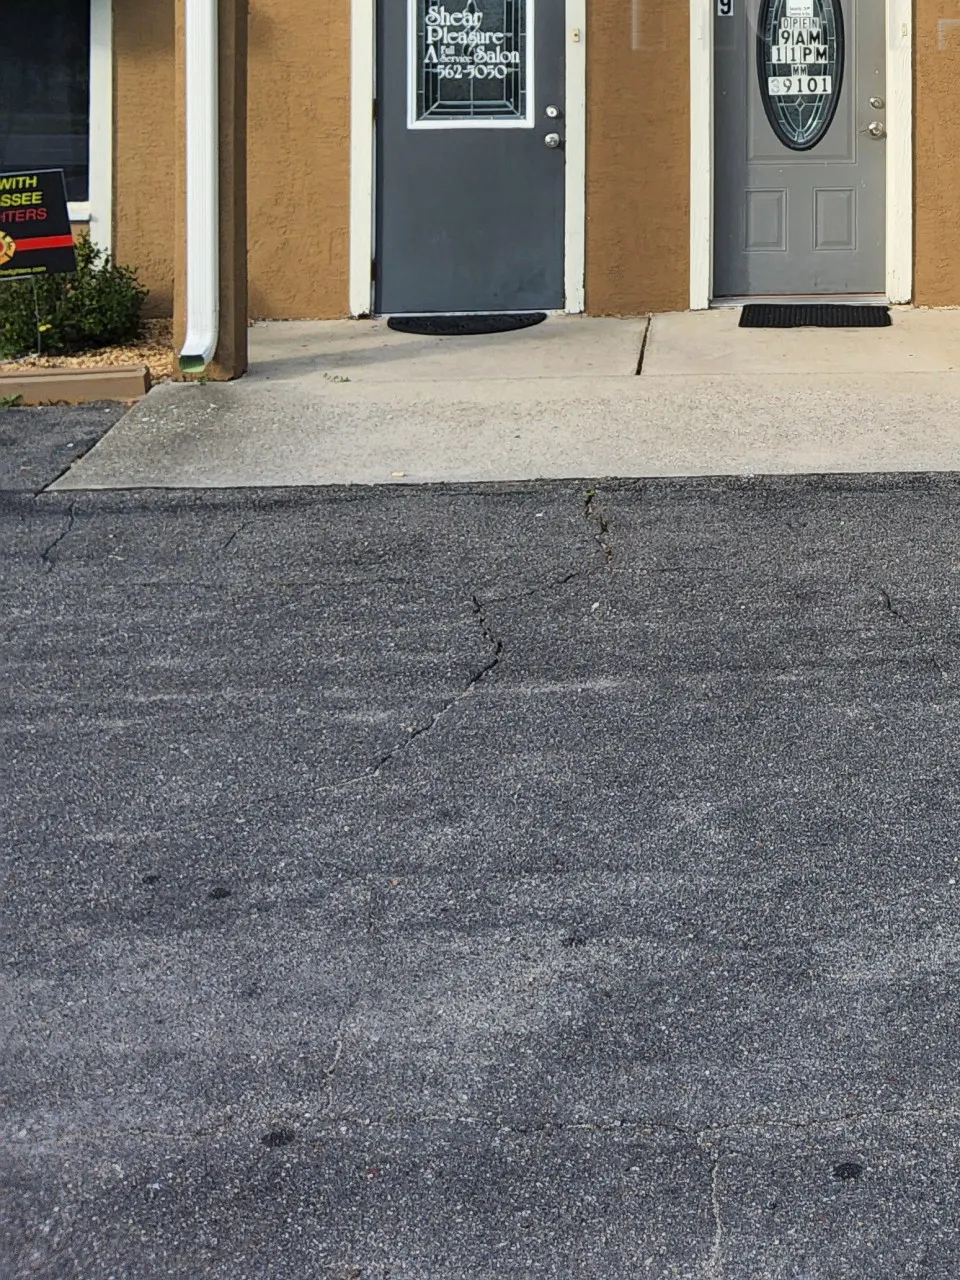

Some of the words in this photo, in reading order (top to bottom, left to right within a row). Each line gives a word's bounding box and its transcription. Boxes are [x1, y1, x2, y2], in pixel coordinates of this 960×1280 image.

[425, 5, 483, 26] Shear
[783, 18, 818, 29] OPEN
[426, 26, 504, 44] Pleasure
[424, 45, 438, 63] A
[440, 45, 455, 55] Full
[473, 45, 520, 63] Salon
[437, 64, 507, 79] 562-5050
